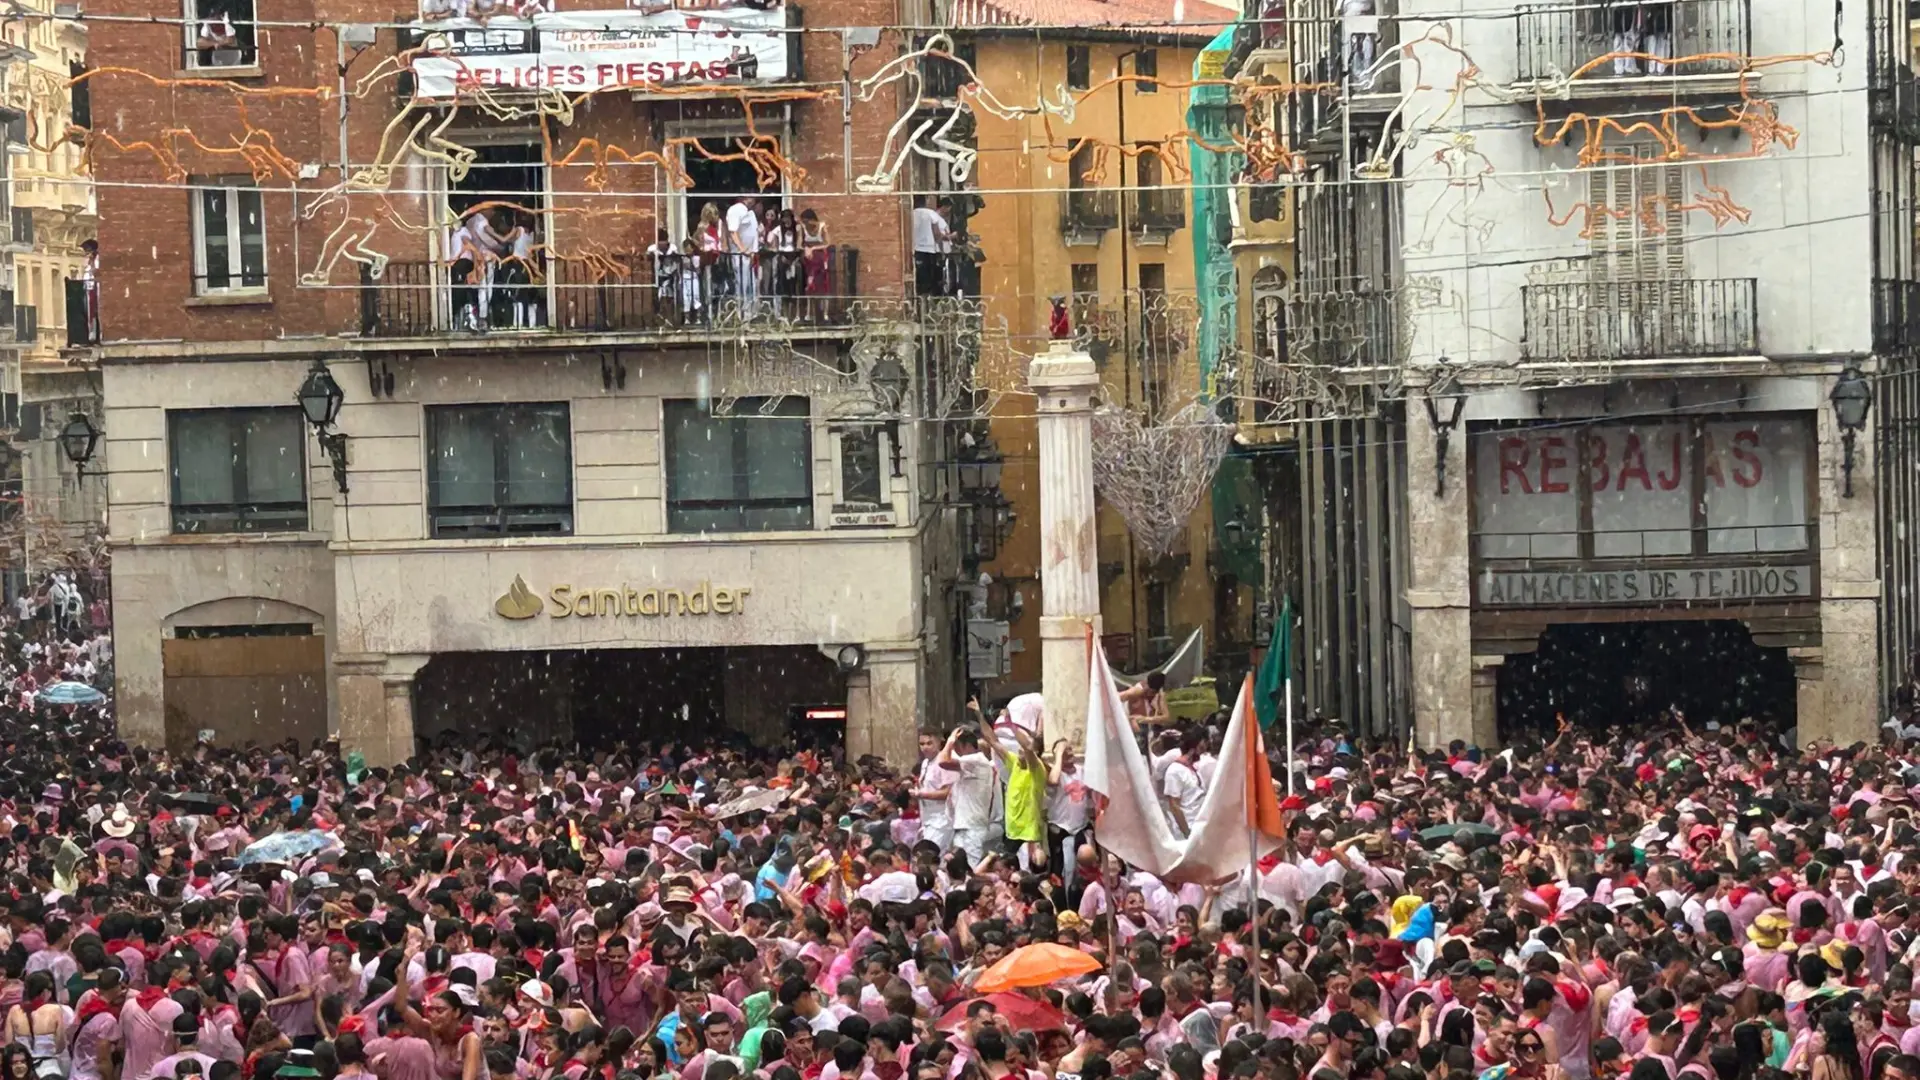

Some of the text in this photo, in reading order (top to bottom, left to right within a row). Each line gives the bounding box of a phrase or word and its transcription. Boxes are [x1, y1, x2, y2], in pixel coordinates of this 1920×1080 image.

[597, 60, 730, 86] FIESTAS
[1500, 430, 1763, 494] REBAJAS
[550, 579, 752, 619] Santander
[1489, 568, 1800, 603] ALMACENES DE TEJIDOS
